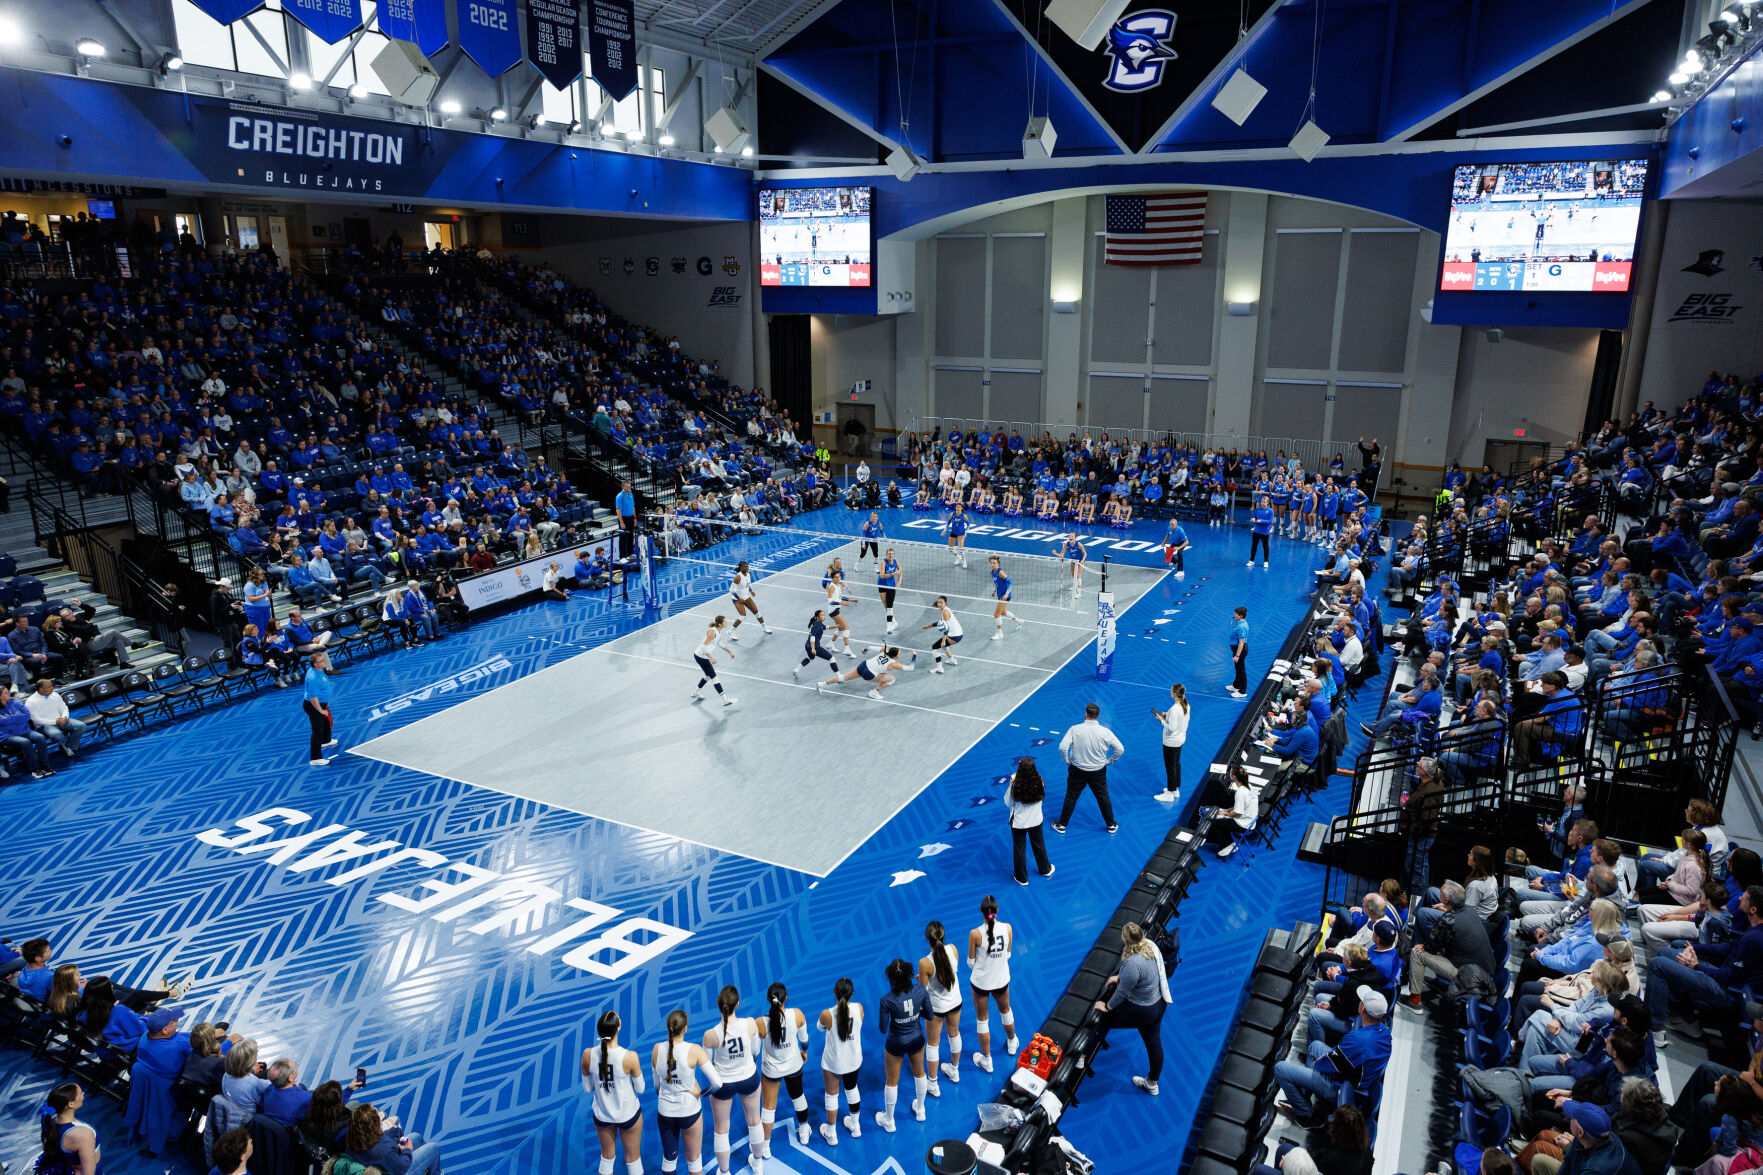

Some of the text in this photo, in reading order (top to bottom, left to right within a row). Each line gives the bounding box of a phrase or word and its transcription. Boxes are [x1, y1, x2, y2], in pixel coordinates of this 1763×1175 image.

[327, 3, 352, 18] 2022
[470, 4, 508, 30] 2022
[556, 4, 577, 17] SEASON
[595, 7, 628, 22] CONFERENCE
[532, 9, 575, 26] CHAMPIONSHIP
[596, 17, 629, 31] TOURNAMENT
[538, 22, 553, 34] 1991
[594, 25, 632, 40] CHAMPIONSHIP
[538, 32, 555, 44] 1992
[537, 42, 556, 54] 2002
[228, 116, 403, 165] CREIGHTON
[266, 171, 382, 191] BLUEJAYS
[697, 257, 713, 276] G
[822, 265, 831, 275] G
[1548, 264, 1562, 276] G
[1477, 278, 1484, 286] 2
[1491, 278, 1498, 286] 0
[1507, 278, 1515, 290] 1
[713, 286, 736, 295] BIG
[1683, 293, 1733, 305] BIG
[1673, 305, 1744, 317] EAST
[478, 581, 503, 594] INDIGO
[367, 658, 513, 722] BIG EAST
[195, 807, 696, 980] BLUEJAYS
[903, 998, 914, 1017] 4
[727, 1036, 744, 1054] 21
